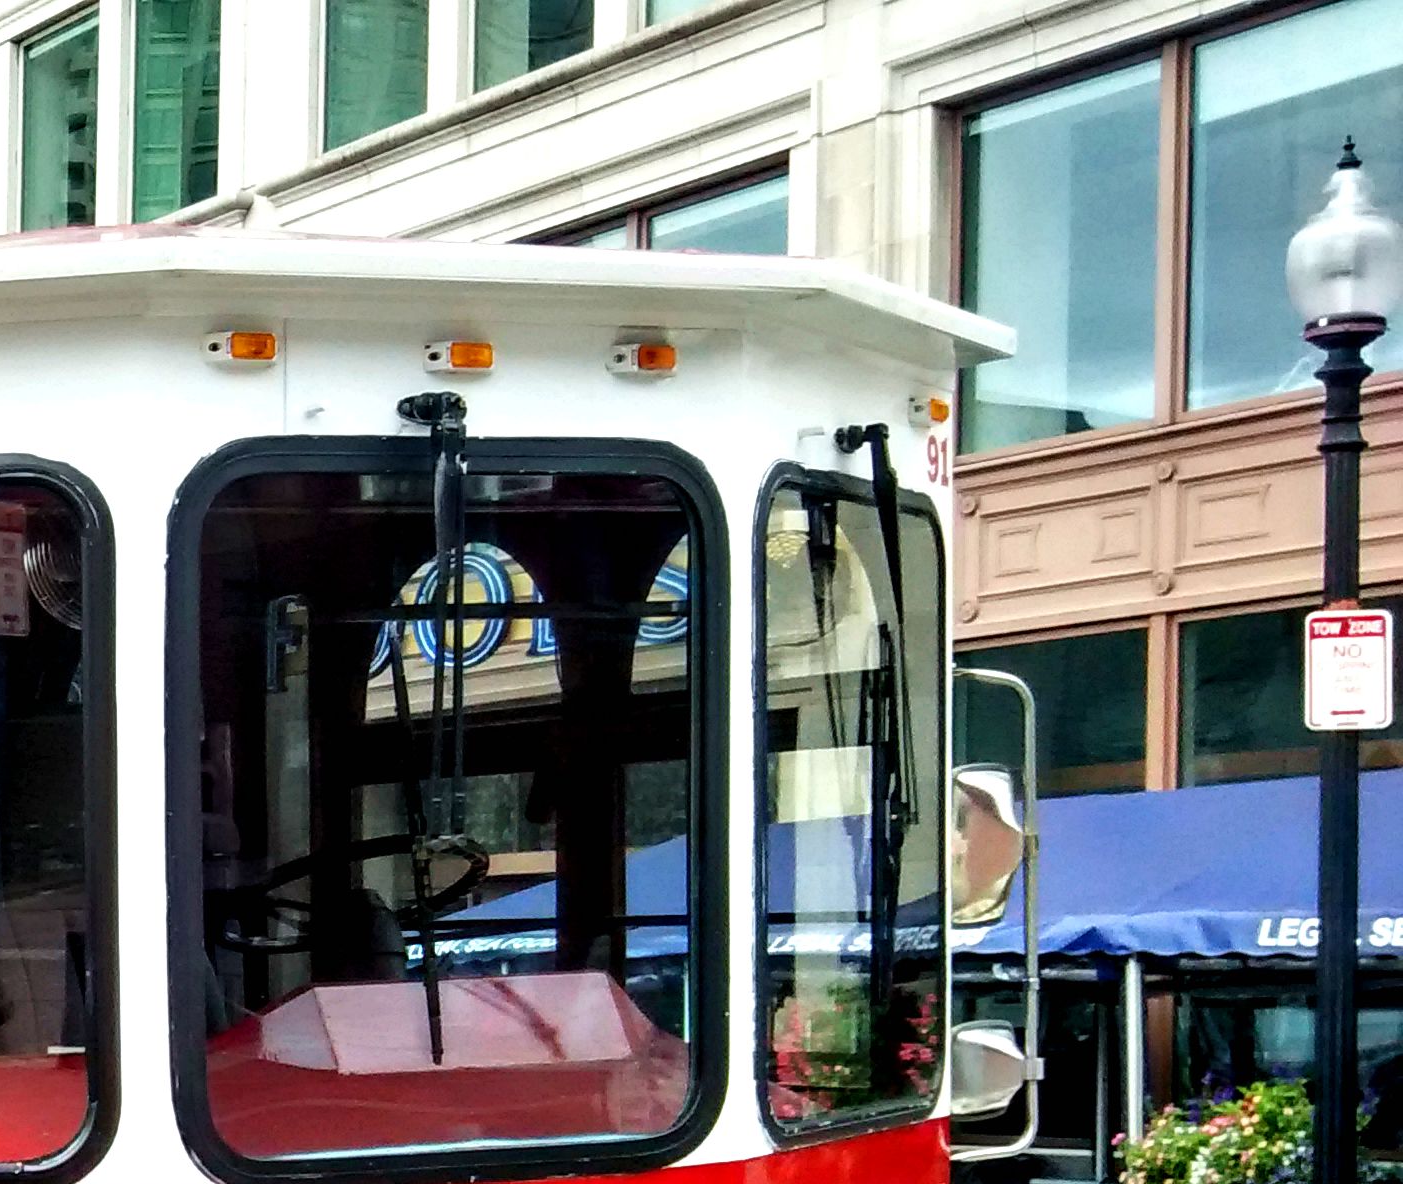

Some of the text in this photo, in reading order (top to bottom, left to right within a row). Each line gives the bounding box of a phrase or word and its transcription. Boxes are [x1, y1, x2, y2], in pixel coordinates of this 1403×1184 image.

[927, 435, 949, 487] 91
[1313, 620, 1383, 635] TOW ZONE
[1334, 644, 1362, 658] NO
